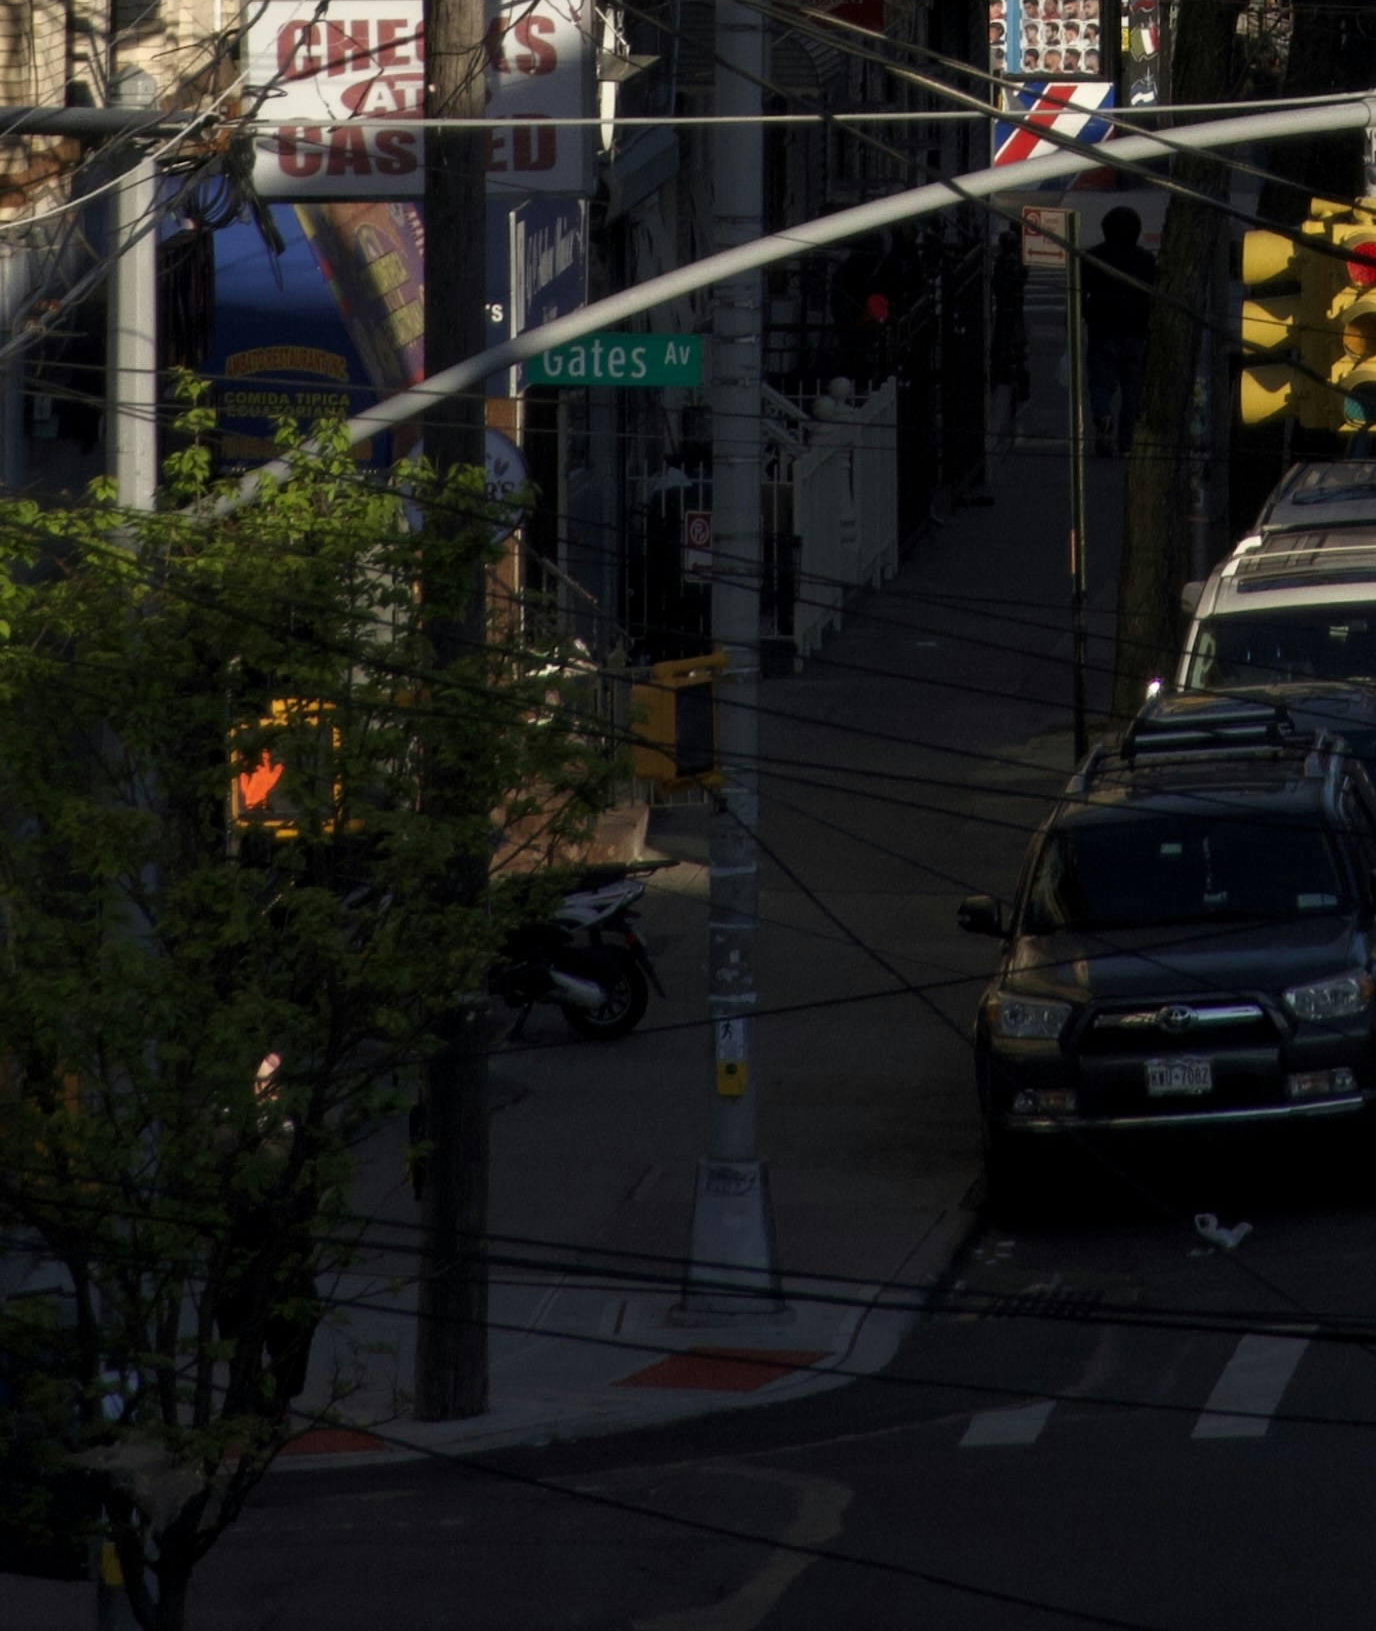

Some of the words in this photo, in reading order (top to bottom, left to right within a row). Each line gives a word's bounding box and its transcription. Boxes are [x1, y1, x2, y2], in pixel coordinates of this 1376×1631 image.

[277, 113, 557, 178] CASED
[542, 339, 648, 379] Gates
[664, 341, 691, 366] Av
[223, 392, 290, 406] COMIDA
[294, 393, 350, 407] TIPICA
